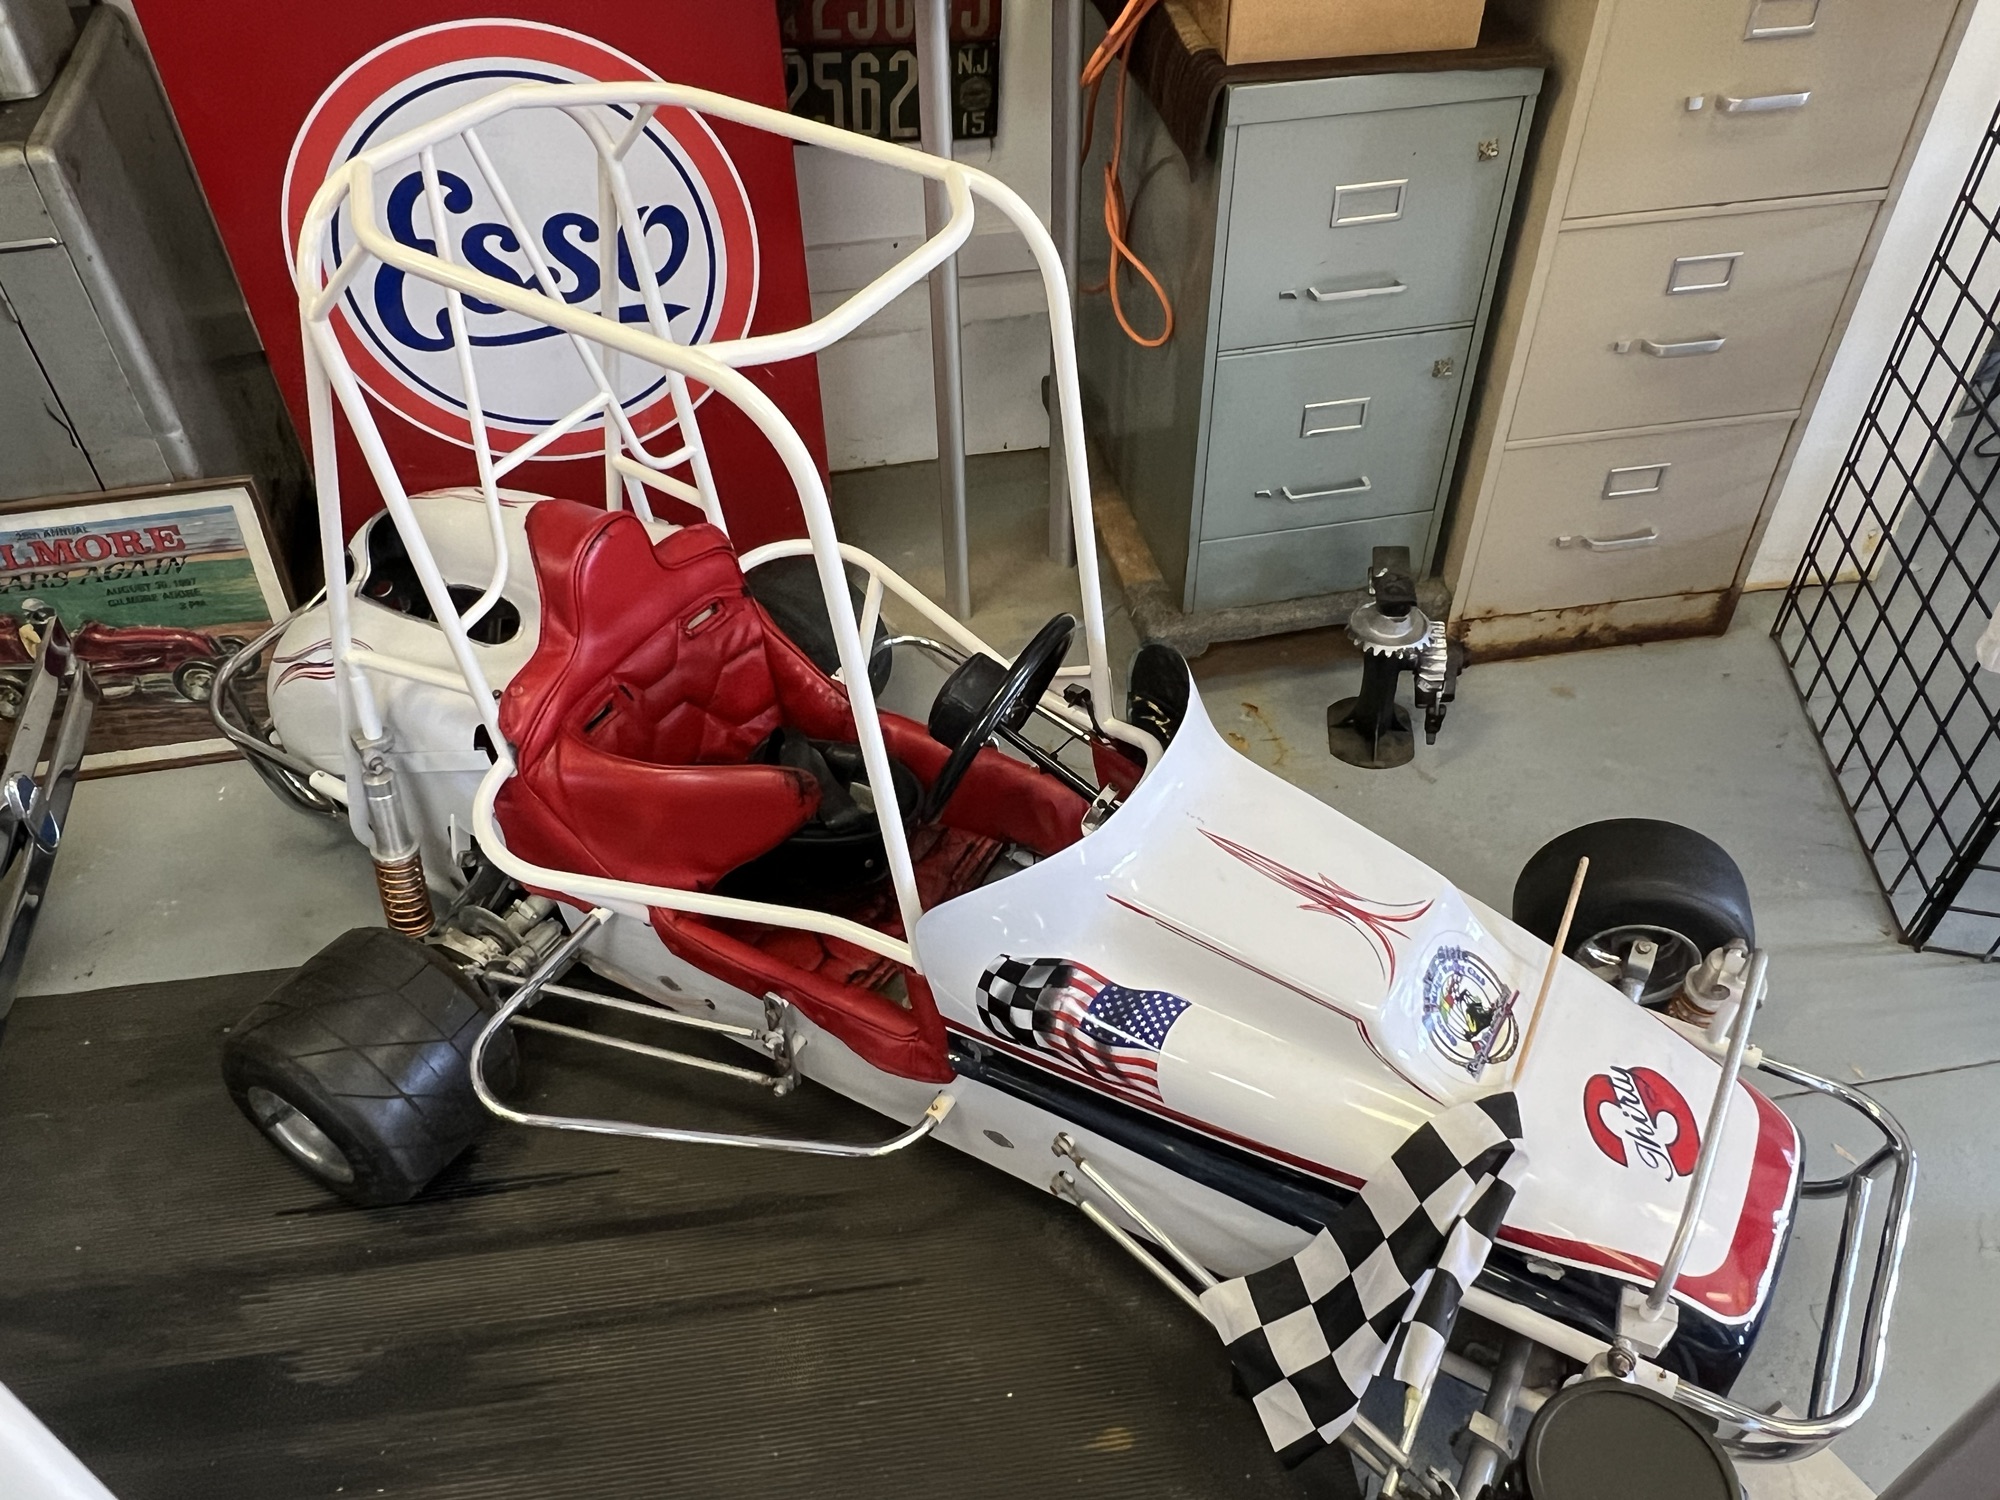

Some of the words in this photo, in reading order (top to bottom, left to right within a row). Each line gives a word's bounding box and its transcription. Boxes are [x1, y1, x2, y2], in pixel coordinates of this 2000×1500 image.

[962, 111, 986, 137] 15
[374, 169, 691, 353] Esso
[79, 556, 188, 585] AGAIN
[106, 582, 150, 597] AUGUST
